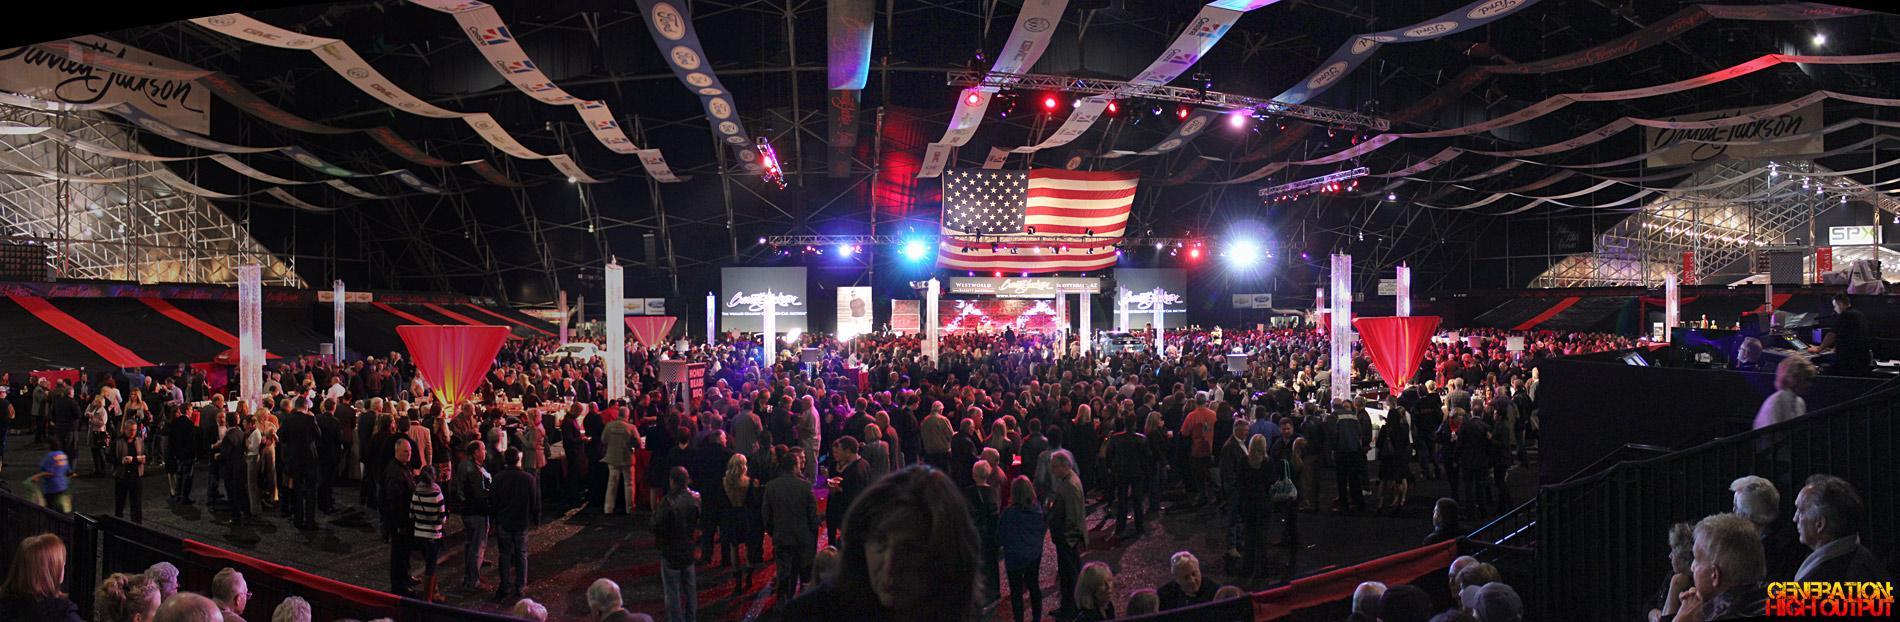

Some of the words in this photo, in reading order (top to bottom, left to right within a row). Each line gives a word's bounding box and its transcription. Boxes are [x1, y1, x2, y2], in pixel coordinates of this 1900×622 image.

[1478, 0, 1516, 15] Ford
[657, 11, 679, 33] Ford
[1189, 17, 1210, 36] Cessna
[1413, 23, 1446, 36] Ford
[243, 27, 283, 41] GMC
[469, 26, 487, 46] Cessna
[1314, 66, 1340, 85] Ford
[370, 83, 398, 99] GMC
[1832, 227, 1876, 240] SPX
[689, 368, 705, 379] HONEY
[690, 378, 704, 389] BEARS
